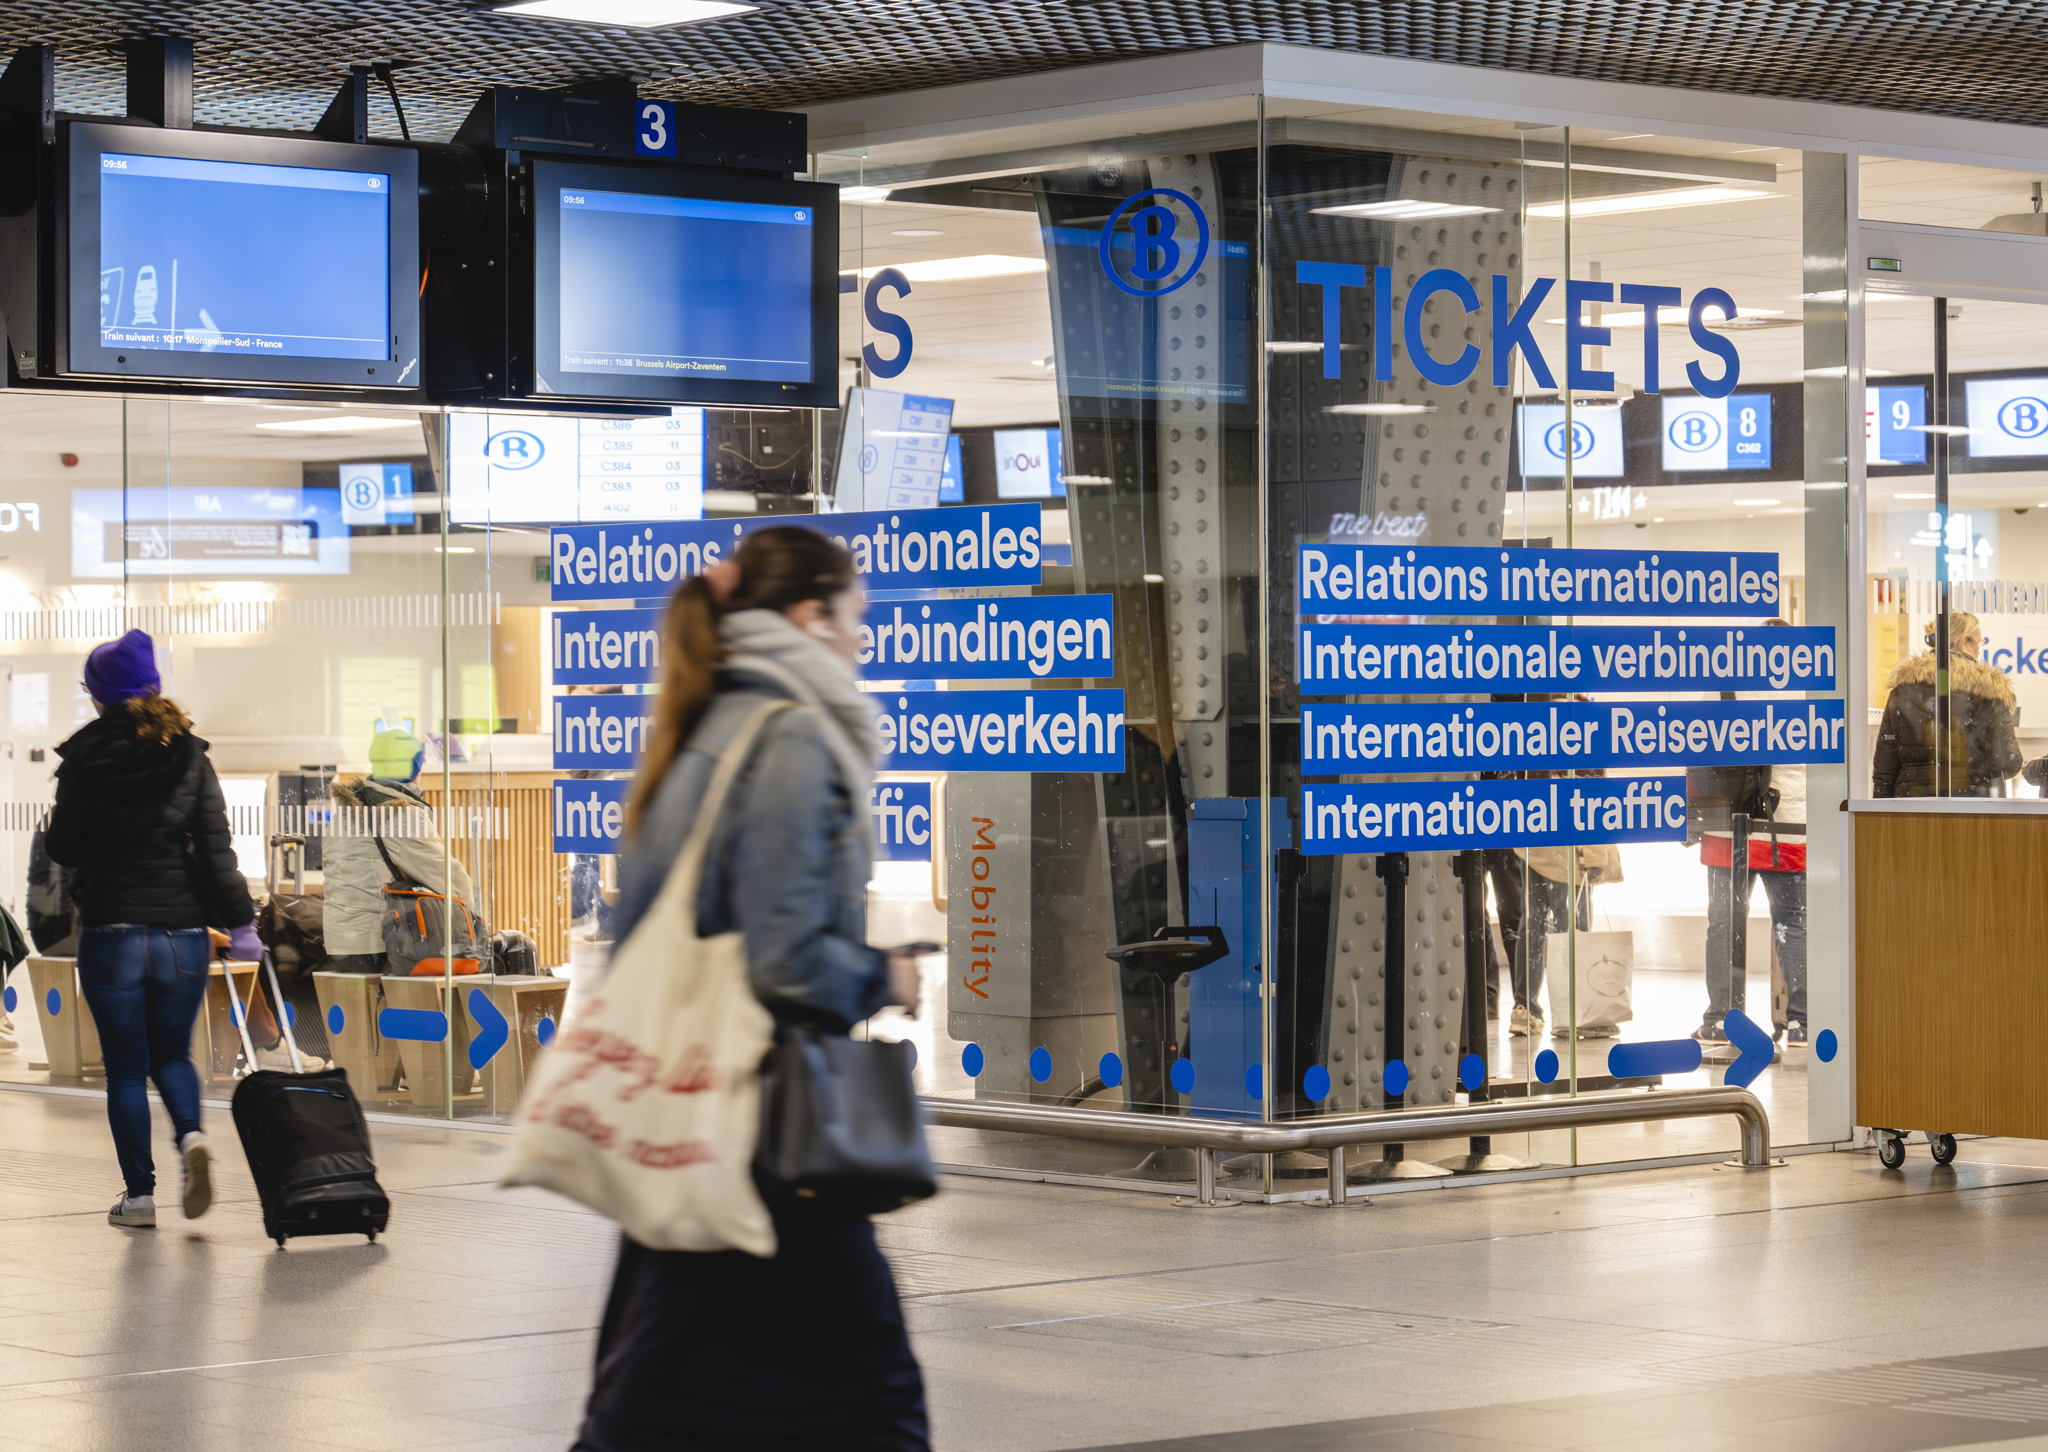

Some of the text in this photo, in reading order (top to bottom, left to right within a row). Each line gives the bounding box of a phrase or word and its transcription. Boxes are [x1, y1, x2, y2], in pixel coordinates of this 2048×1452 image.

[641, 104, 668, 150] 3
[103, 160, 127, 169] 09:56
[564, 196, 585, 204] 09:56
[104, 332, 124, 342] Train
[126, 334, 155, 343] suivant
[163, 335, 183, 344] 10:17
[256, 339, 283, 349] France
[1296, 260, 1742, 399] TICKETS
[635, 358, 664, 369] Brussels
[665, 360, 727, 372] Airport-Zaventem
[665, 419, 681, 431] 03
[1739, 408, 1757, 437] 8
[1892, 400, 1911, 430] 9
[602, 440, 633, 452] C385
[601, 460, 681, 472] C384 03
[391, 474, 402, 498] 1
[601, 481, 681, 492] C383 03
[552, 527, 721, 585] Relations
[1302, 549, 1779, 605] Relations internationales
[852, 603, 1111, 676] erbindingen
[1983, 636, 2048, 675] icke
[1302, 629, 1834, 690] Internationale verbindingen
[875, 695, 1124, 755] eiseverkehr
[1303, 705, 1845, 761] Internationaler Reiseverkehr
[1303, 780, 1687, 841] International traffic
[963, 816, 997, 1000] Mobility
